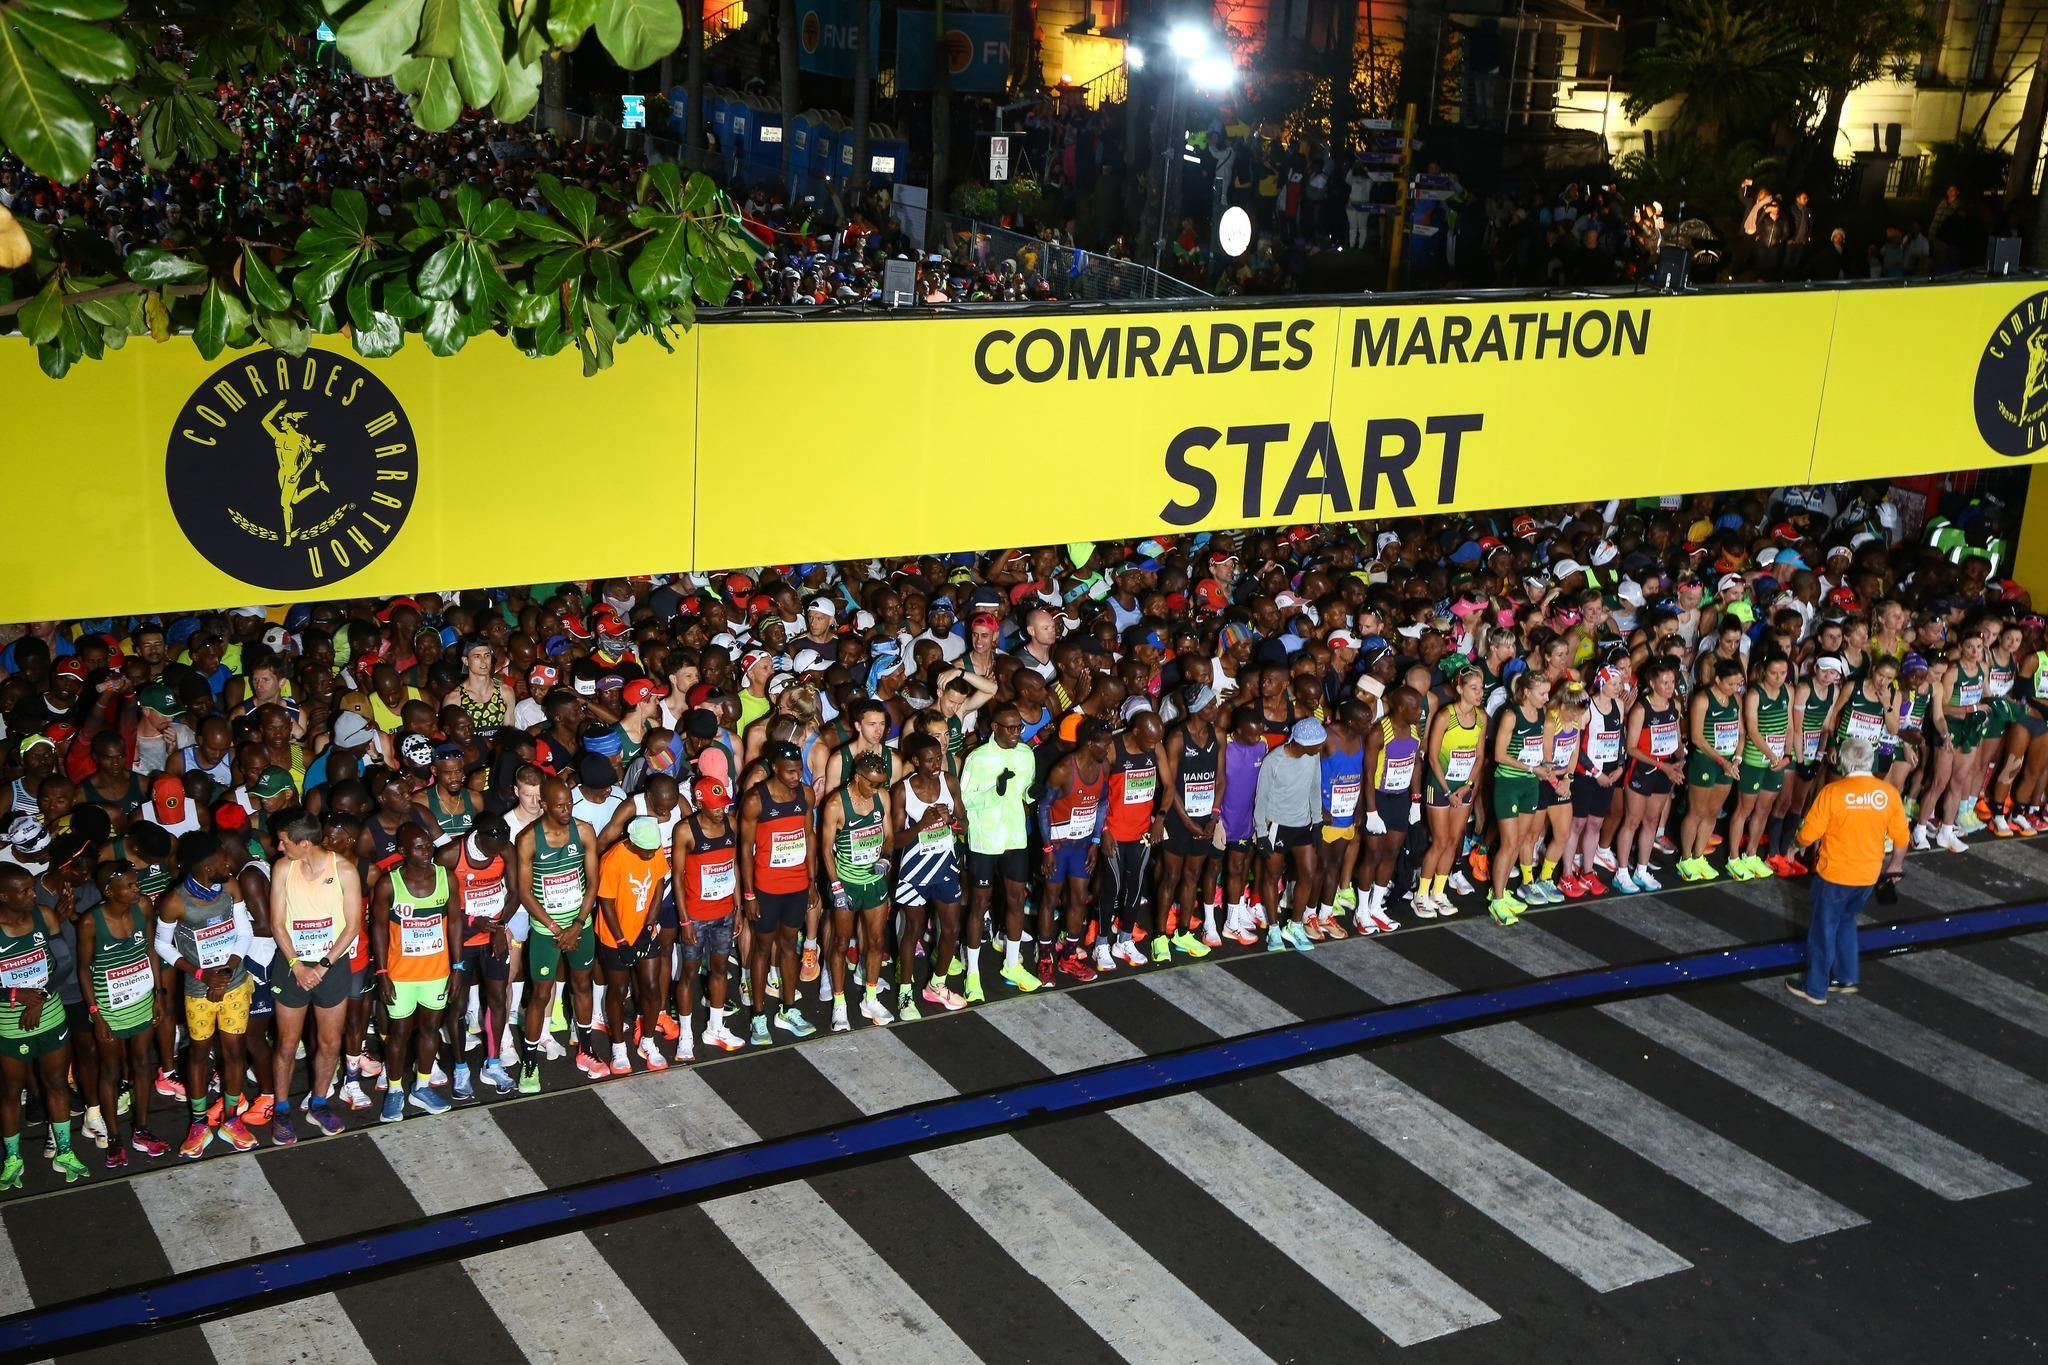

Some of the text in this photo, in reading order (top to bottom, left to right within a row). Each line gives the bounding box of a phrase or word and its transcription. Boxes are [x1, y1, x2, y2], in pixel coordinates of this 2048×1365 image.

[995, 142, 1002, 153] 4
[974, 309, 1651, 384] COMRADES MARATHON
[183, 357, 409, 578] COMRADES MARATHON
[1158, 413, 1484, 526] START
[858, 838, 880, 849] Wayne
[469, 887, 500, 898] THIRSTI
[395, 903, 412, 917] 40
[294, 920, 332, 929] THIRSTI
[404, 917, 440, 927] THIRSTI
[200, 922, 233, 939] THIRSTI
[299, 931, 329, 941] Andrew
[322, 940, 334, 952] 40
[431, 937, 443, 949] 40
[2, 952, 43, 969] THIRSTI
[11, 966, 41, 980] Degefa
[110, 960, 148, 978] THIRSTI
[112, 973, 150, 989] Onalenna
